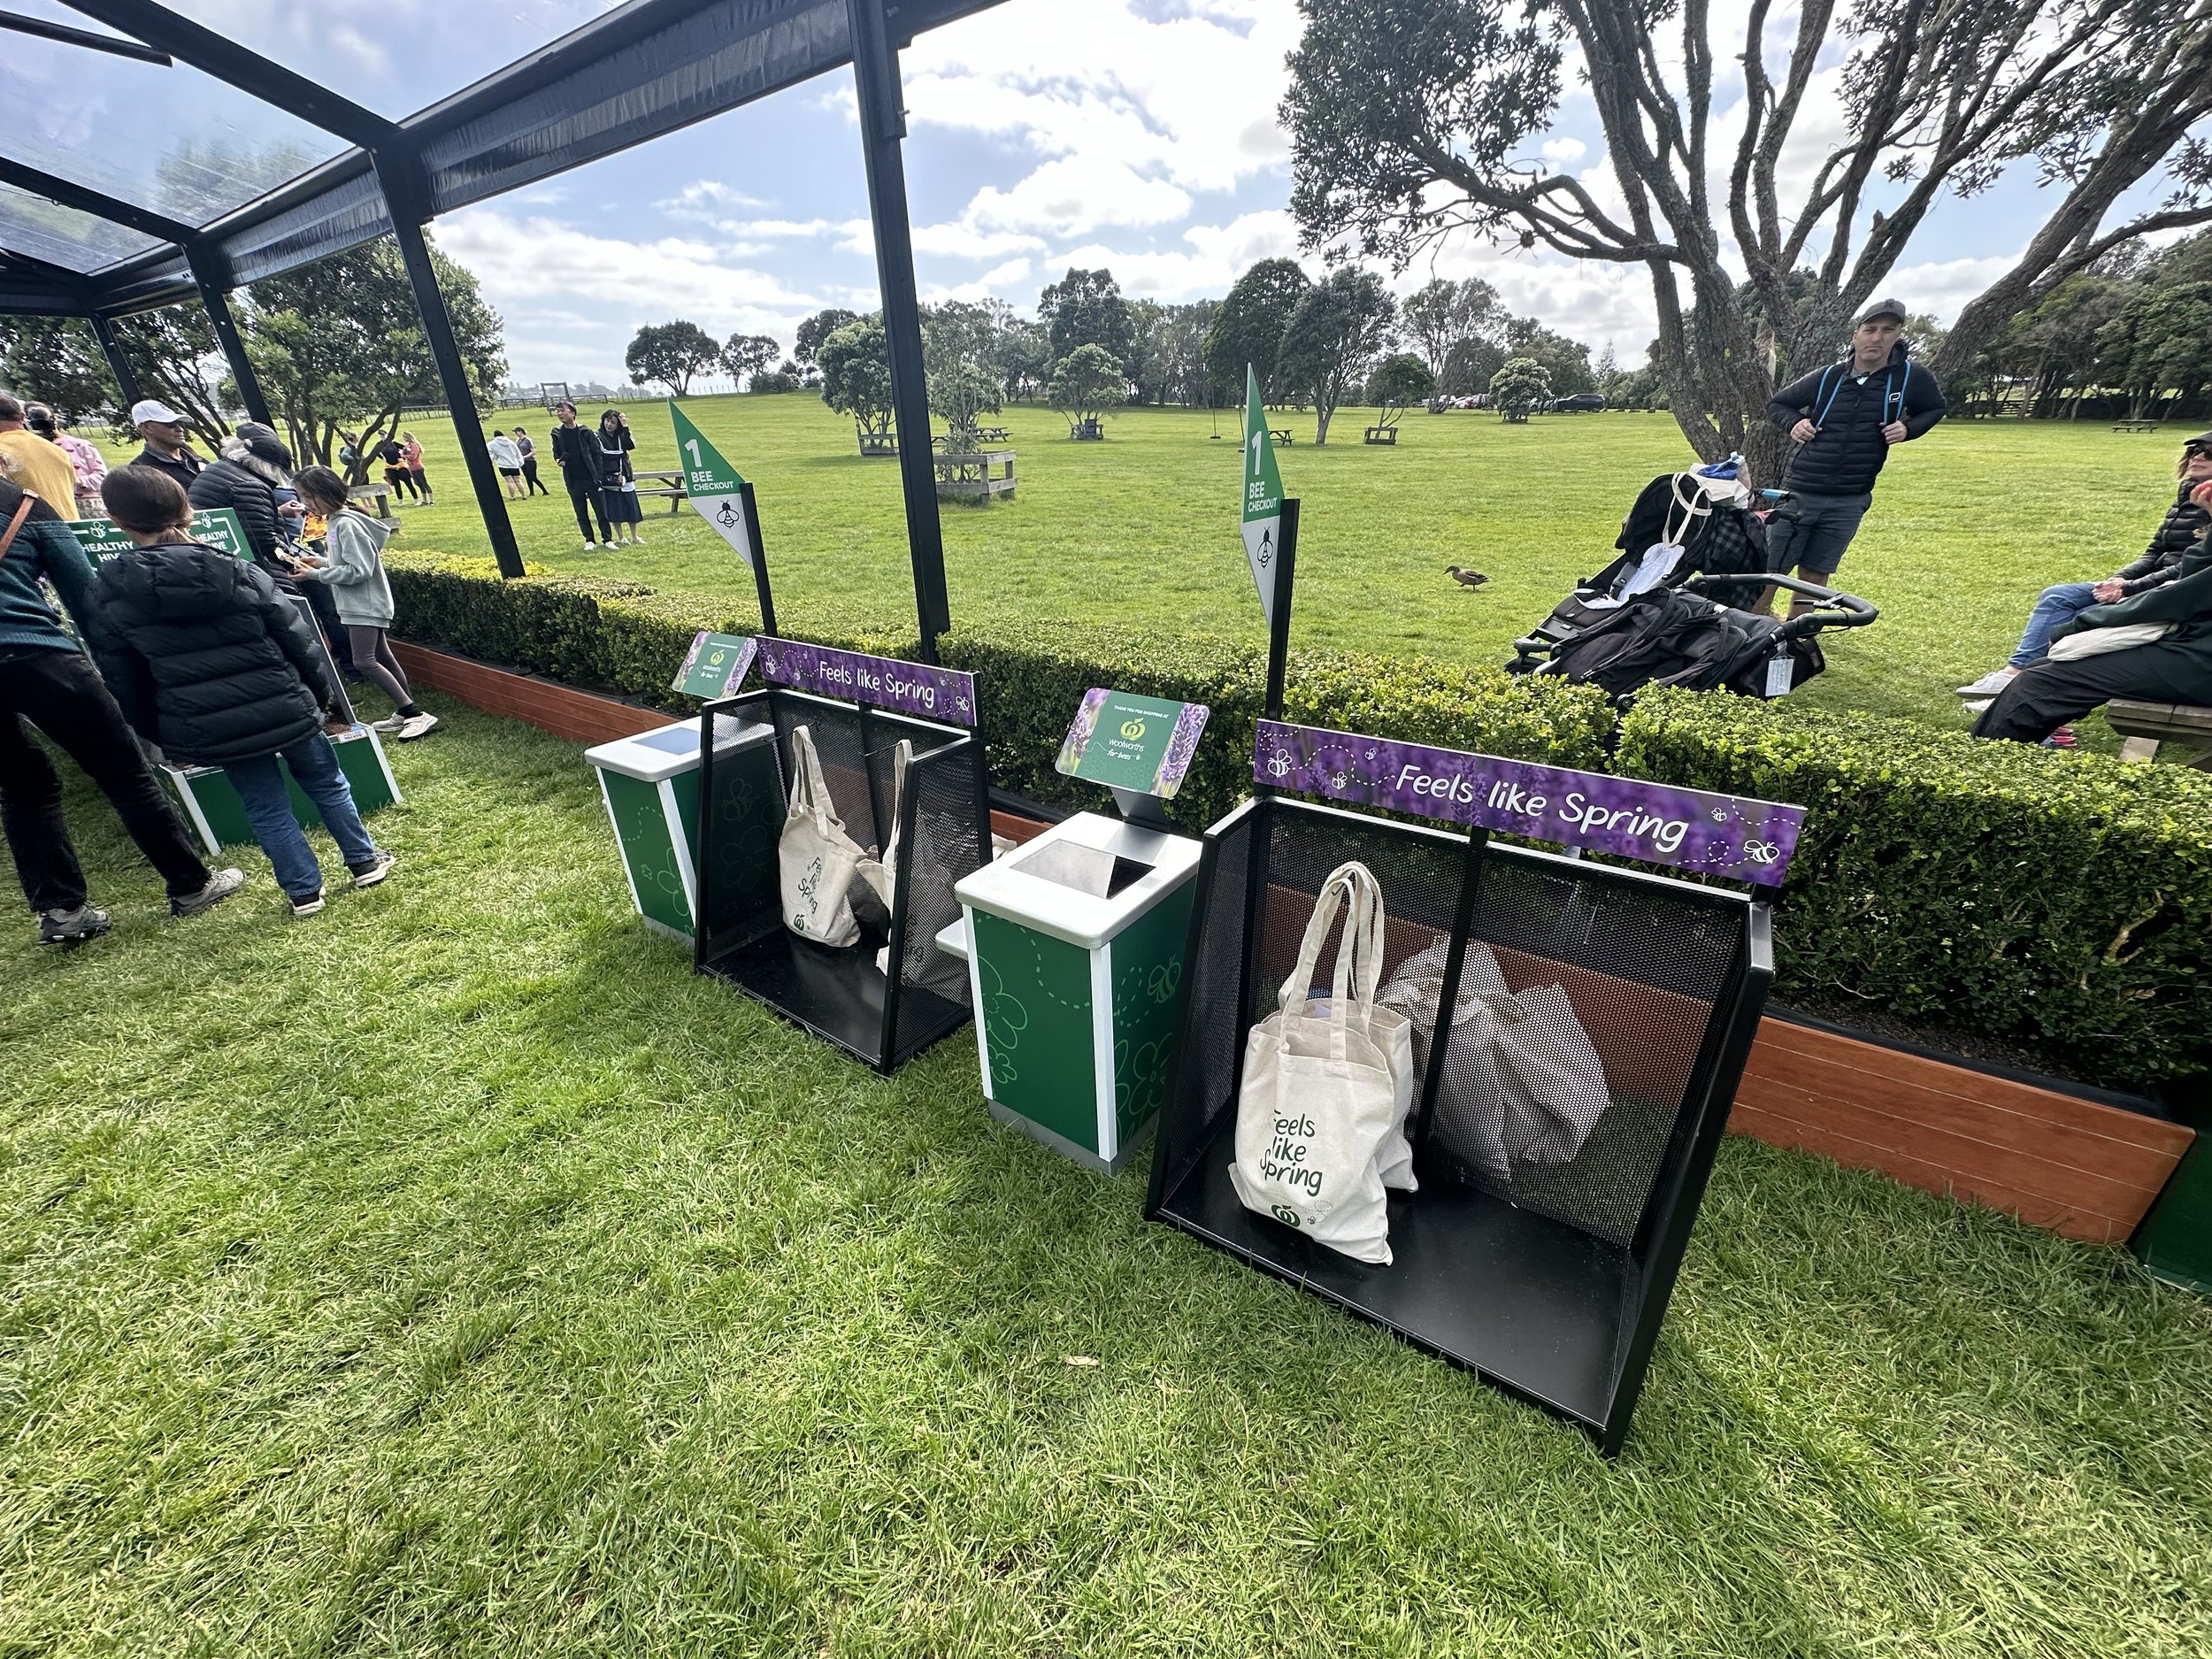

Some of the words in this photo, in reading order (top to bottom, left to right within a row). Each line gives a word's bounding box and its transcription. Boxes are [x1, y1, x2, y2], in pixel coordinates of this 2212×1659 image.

[684, 438, 703, 468] 1
[1251, 431, 1263, 475] 1
[690, 470, 714, 483] BEE
[693, 480, 734, 492] CHECKOUT
[1248, 480, 1265, 500] BEE
[1248, 497, 1278, 513] CHECKOUT
[97, 552, 121, 563] HIV
[819, 660, 852, 686] Feels
[856, 667, 880, 691] like
[885, 672, 934, 709] Spring
[1107, 748, 1119, 757] for
[1118, 751, 1132, 761] bees
[1395, 764, 1474, 804] Feels
[1487, 780, 1548, 818] like
[1558, 792, 1690, 854] Spring
[1272, 1136, 1308, 1163] like
[1259, 1148, 1324, 1197] Spring
